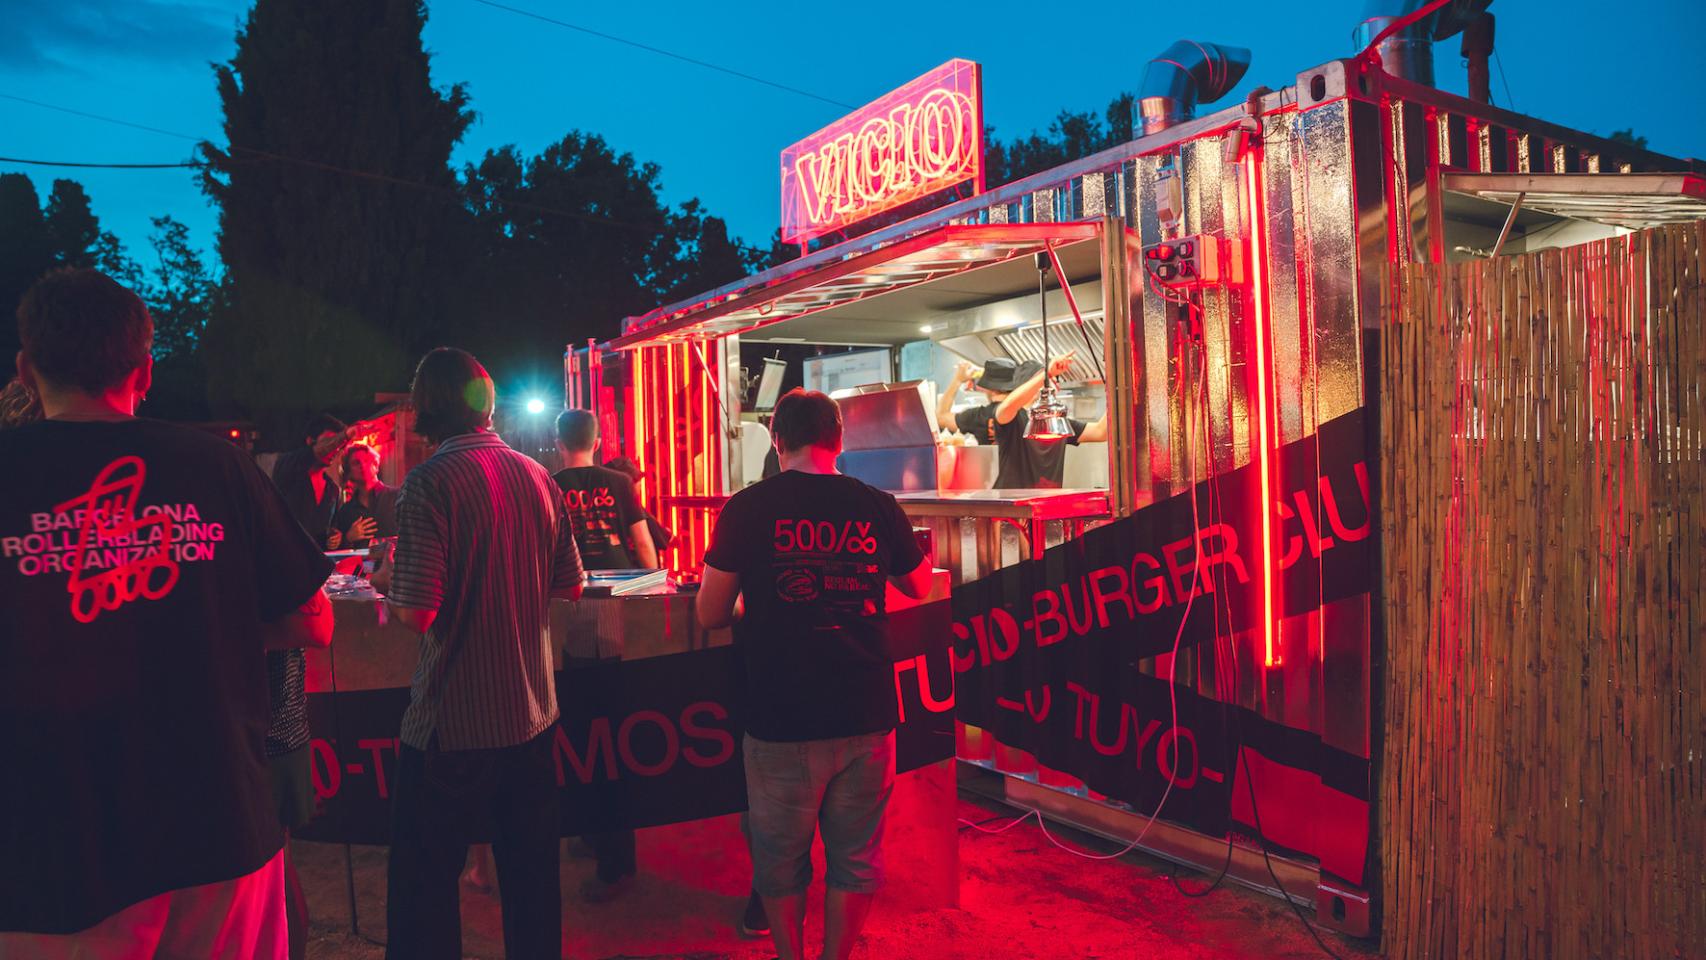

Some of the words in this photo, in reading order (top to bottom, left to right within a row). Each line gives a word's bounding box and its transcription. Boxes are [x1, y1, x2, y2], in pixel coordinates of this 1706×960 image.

[796, 89, 964, 223] VICIO
[1, 522, 225, 557] ROLLERBLADING
[31, 503, 201, 533] BARCEONA
[310, 736, 400, 799] O-T
